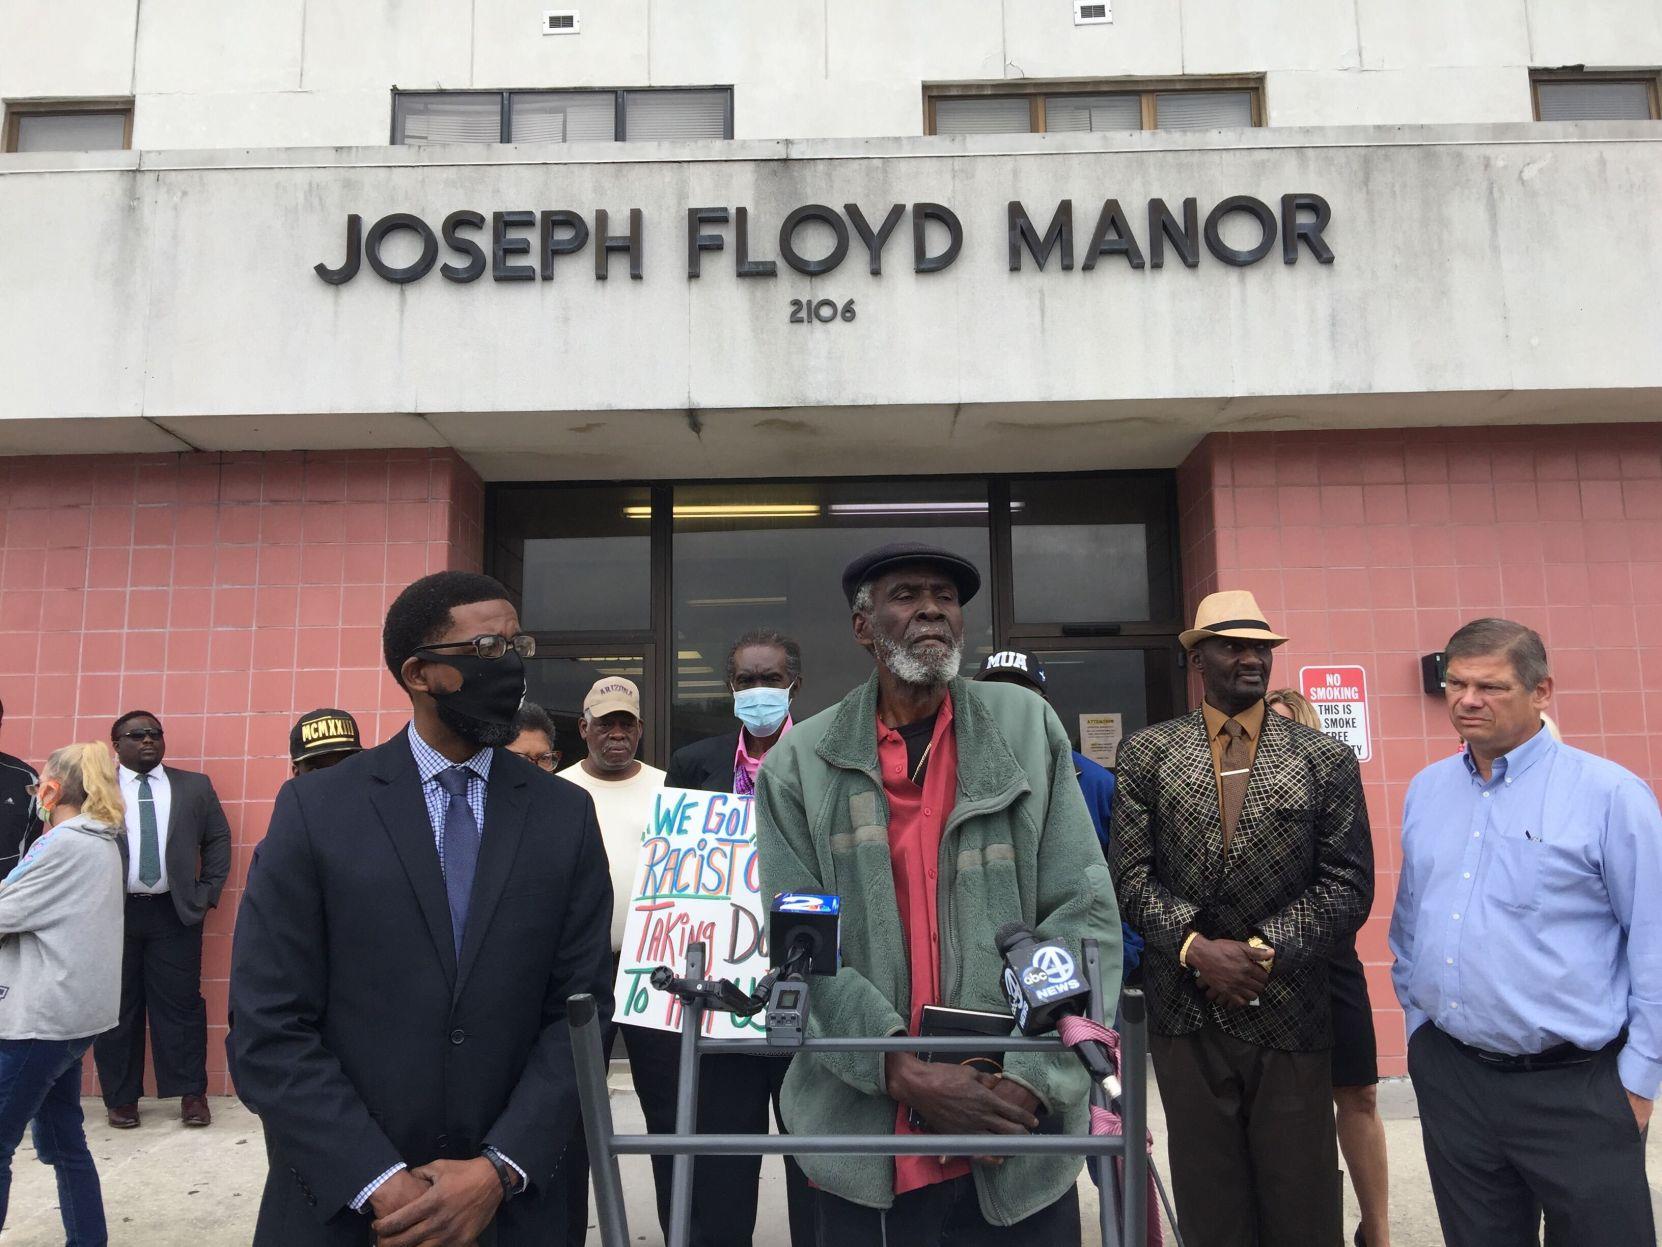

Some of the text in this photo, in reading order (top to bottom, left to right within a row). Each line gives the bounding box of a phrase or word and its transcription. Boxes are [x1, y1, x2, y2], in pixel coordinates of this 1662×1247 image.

[313, 193, 1335, 285] JOSEPH FLOYD MANOR
[789, 298, 856, 324] 2106
[986, 651, 1028, 672] MUA
[1325, 673, 1341, 687] NO
[600, 684, 633, 697] ARIZONA
[1309, 686, 1359, 701] SMOKING
[1318, 703, 1352, 716] THIS IS
[301, 719, 354, 742] MCMXXIII
[1324, 717, 1357, 729] SMOKE
[1325, 731, 1349, 742] REE
[654, 792, 699, 836] WE
[1023, 970, 1047, 985] abc
[1035, 979, 1080, 1000] NEWS
